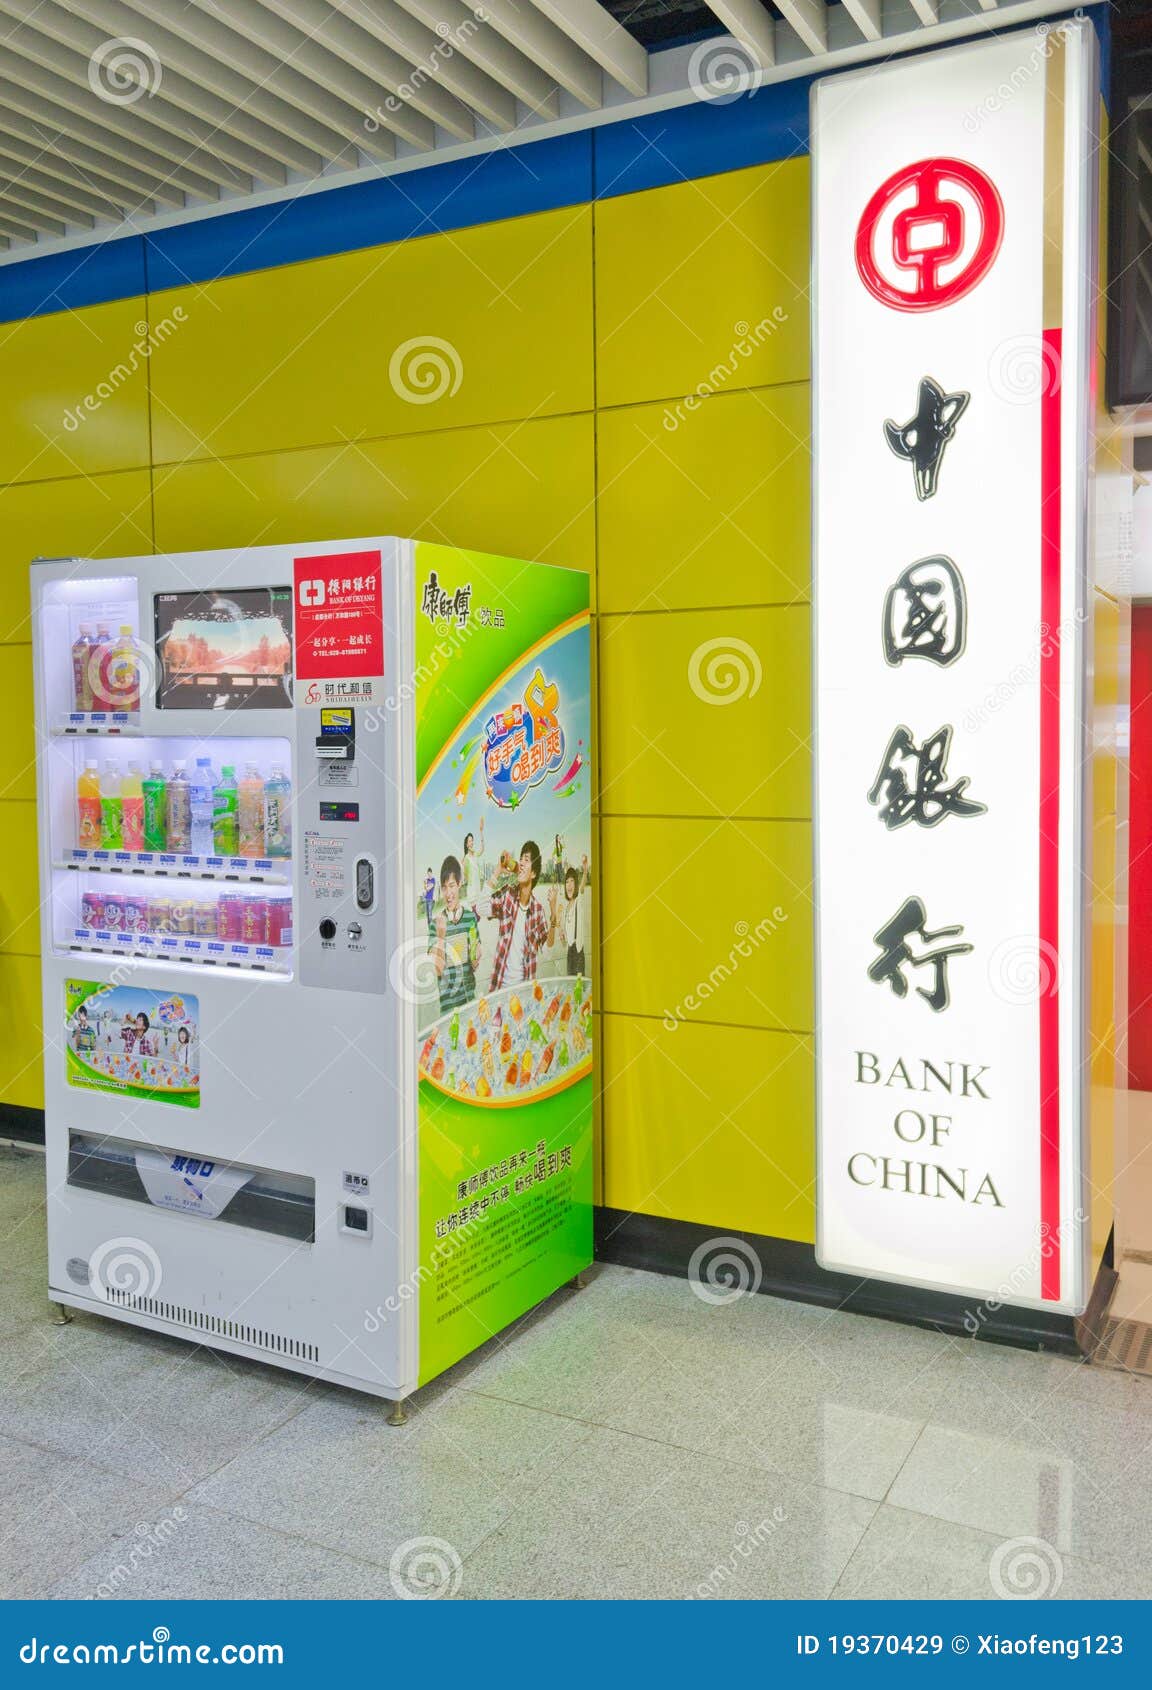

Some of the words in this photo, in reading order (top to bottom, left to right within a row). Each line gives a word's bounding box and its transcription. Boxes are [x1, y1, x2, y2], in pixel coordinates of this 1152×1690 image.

[487, 727, 527, 776] 好手气
[511, 727, 562, 783] 喝到爽
[854, 1050, 992, 1100] BANK
[893, 1108, 953, 1148] OF
[847, 1152, 1006, 1209] CHINA
